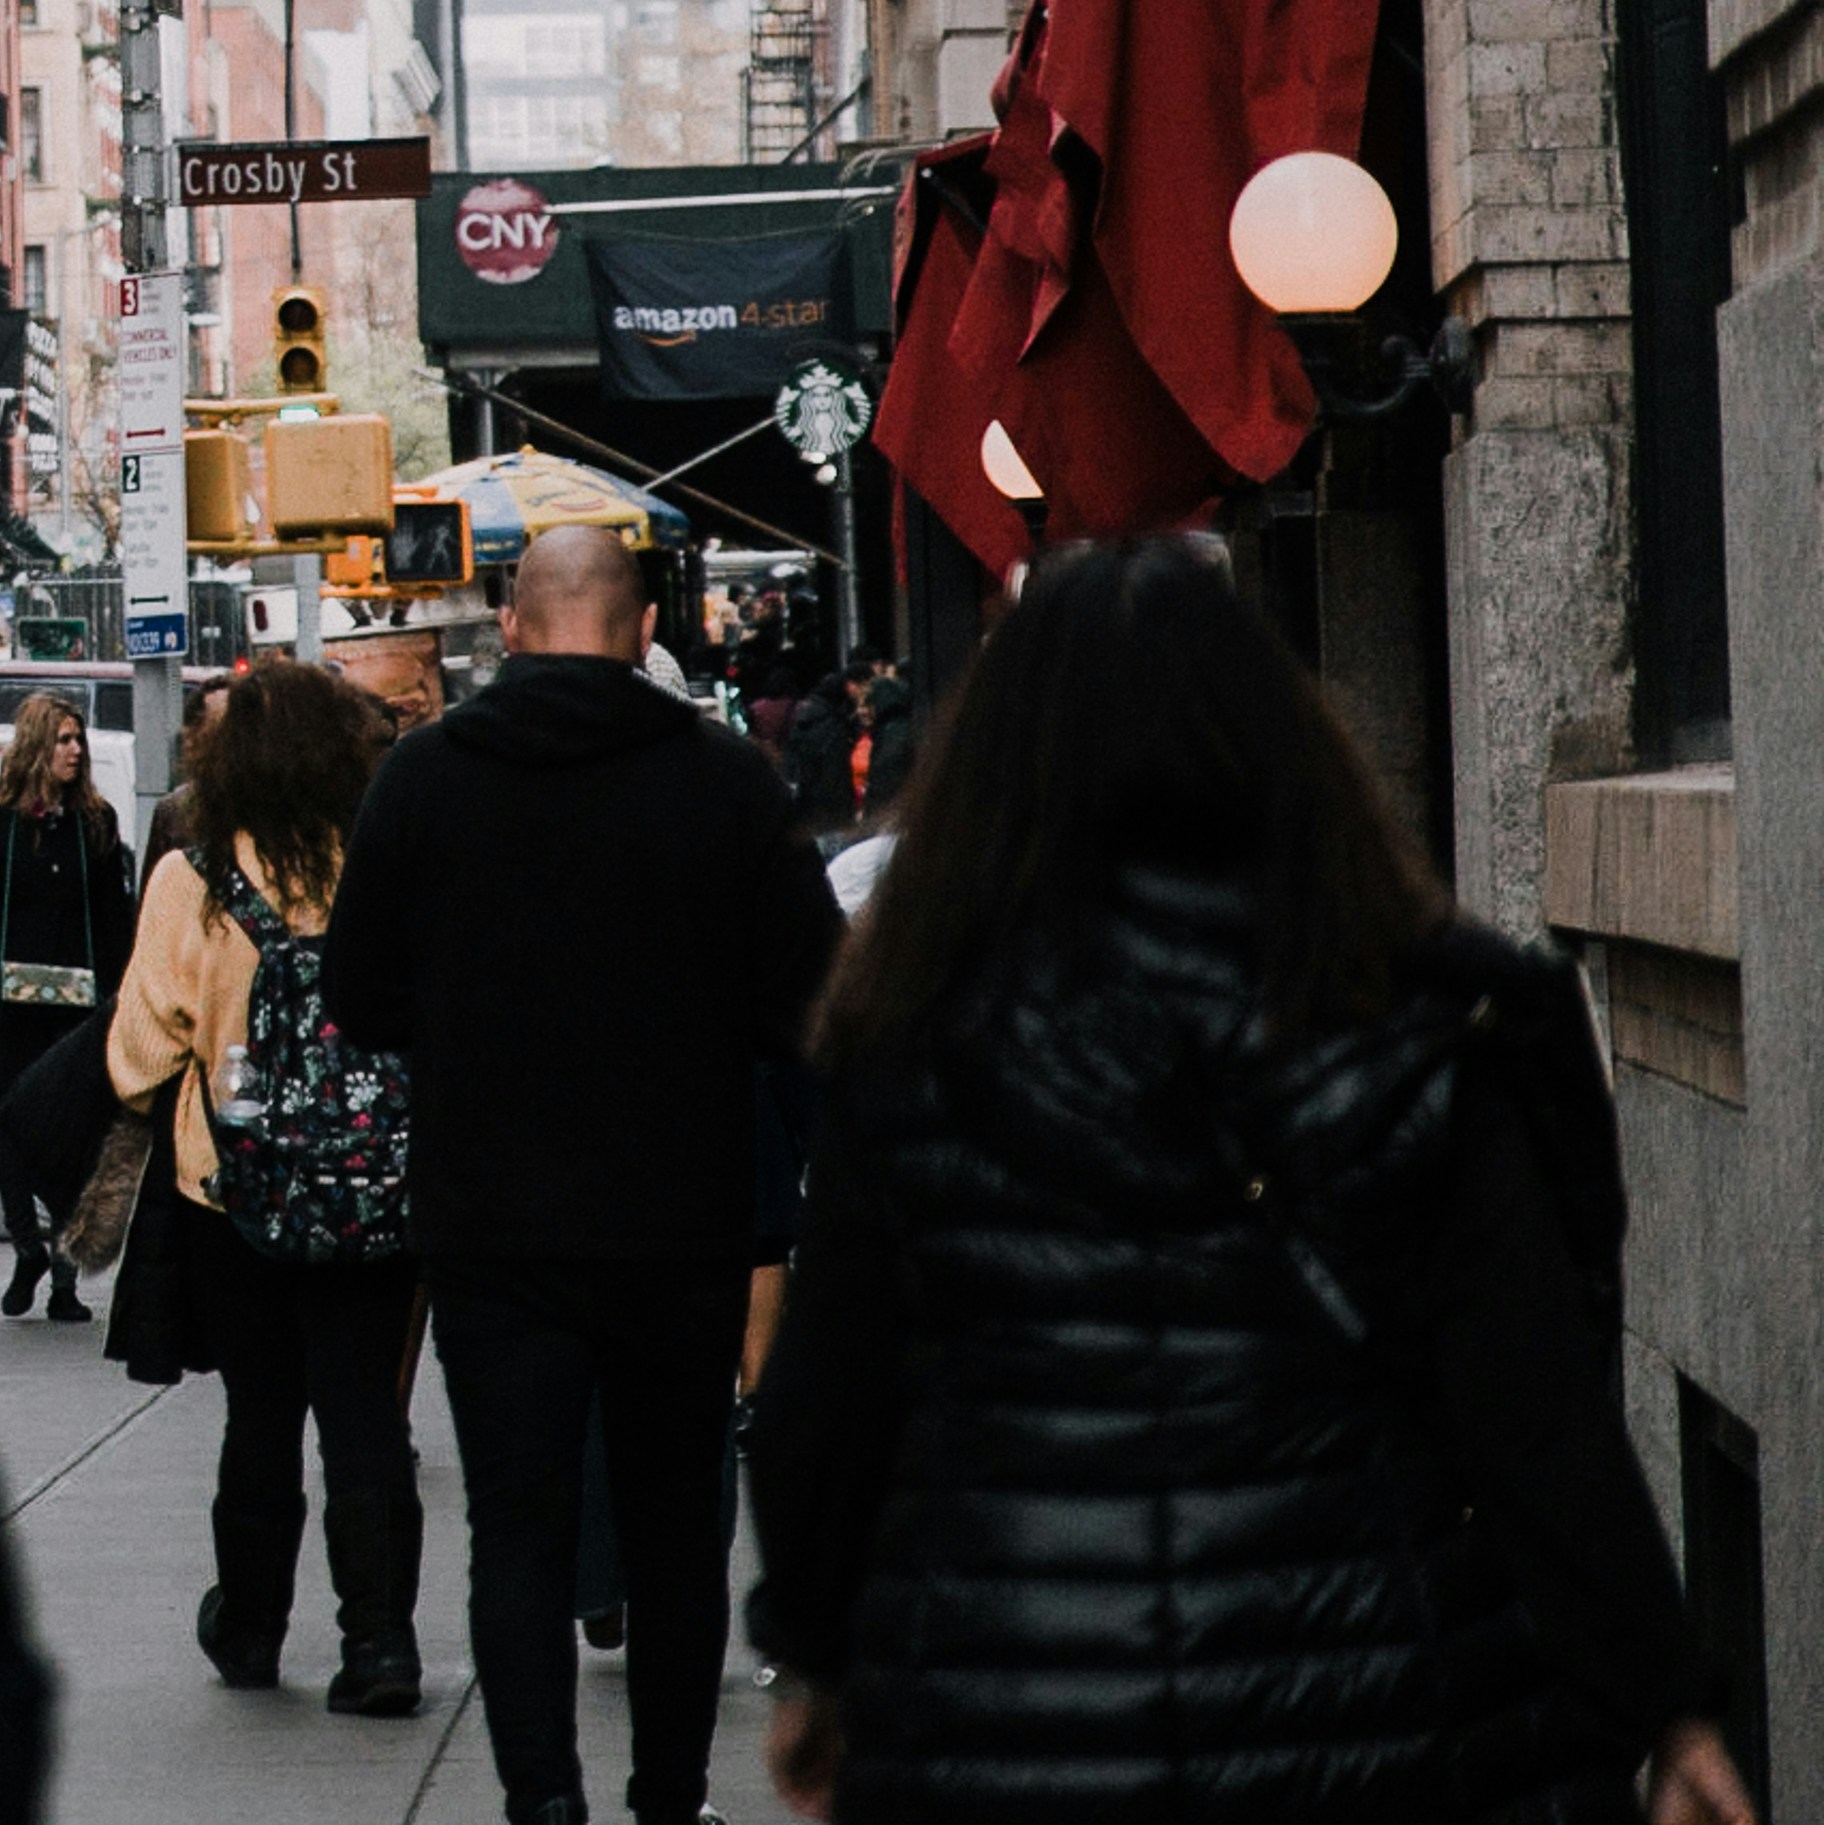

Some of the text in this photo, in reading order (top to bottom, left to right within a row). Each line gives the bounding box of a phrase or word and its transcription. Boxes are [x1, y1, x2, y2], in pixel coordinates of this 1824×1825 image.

[183, 151, 358, 202] Crosby St
[459, 212, 551, 251] CNY
[123, 280, 137, 315] 3
[613, 296, 828, 332] amazon 4-star
[125, 457, 138, 491] 2
